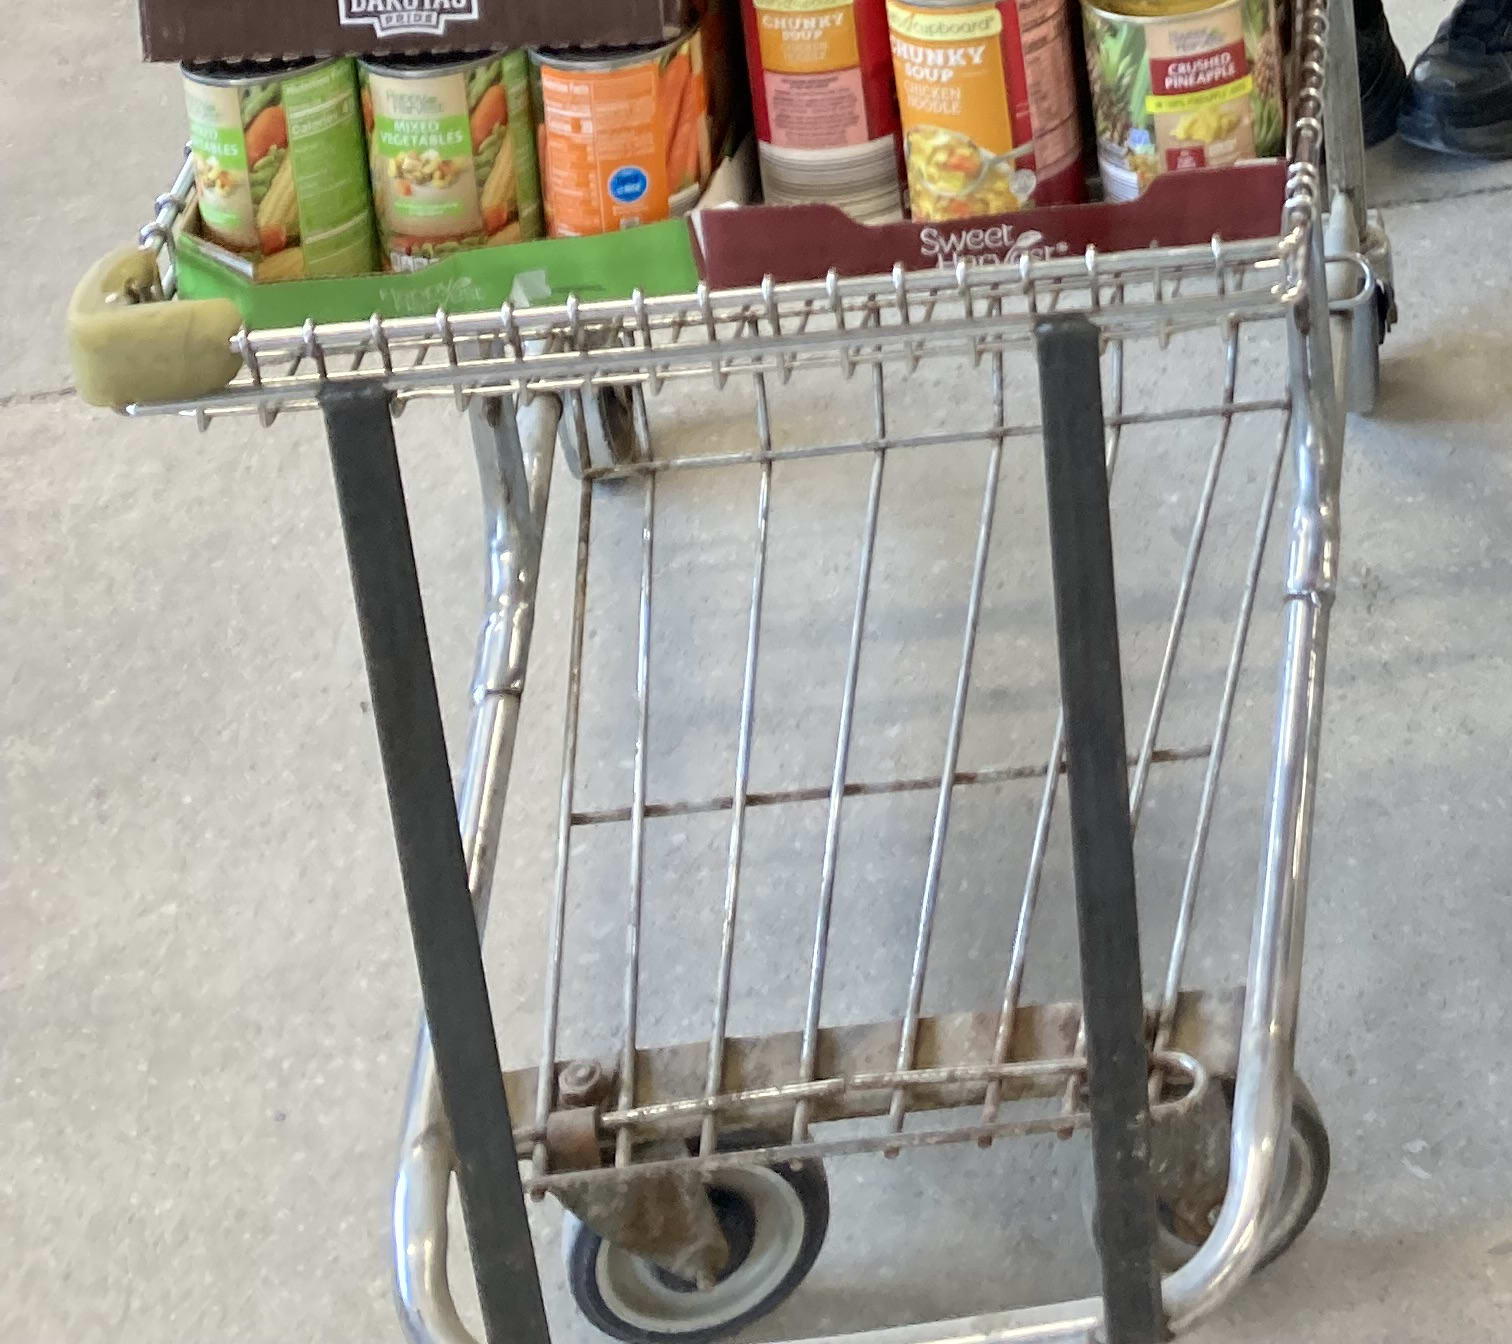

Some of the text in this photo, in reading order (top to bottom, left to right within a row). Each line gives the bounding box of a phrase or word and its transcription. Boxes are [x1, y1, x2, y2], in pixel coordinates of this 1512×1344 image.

[385, 13, 433, 25] PRIDE
[762, 12, 844, 30] CHUNKY
[781, 29, 824, 42] SOUP
[1168, 52, 1232, 75] CRUSHED
[905, 64, 954, 82] SOUP
[1165, 63, 1236, 90] PINEAPPLE
[394, 119, 440, 132] MIXED
[380, 130, 464, 146] VEGETABLES
[920, 223, 1015, 256] Sweet
